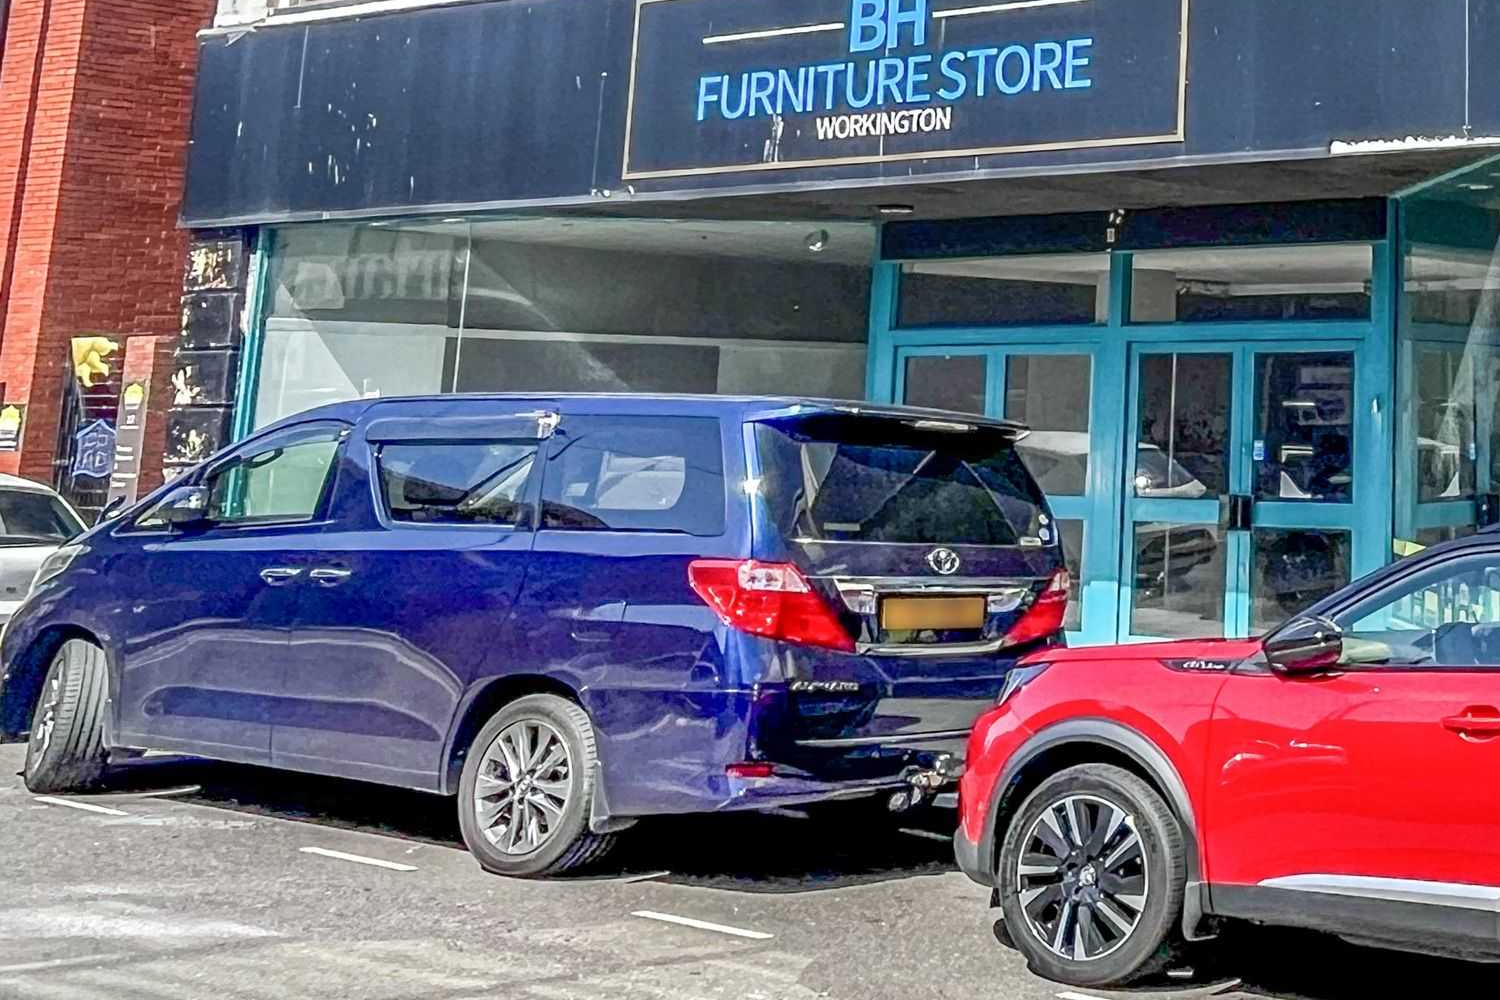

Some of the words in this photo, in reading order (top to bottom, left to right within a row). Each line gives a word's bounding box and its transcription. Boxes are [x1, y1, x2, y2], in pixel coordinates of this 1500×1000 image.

[696, 54, 932, 121] FURNITURE
[935, 38, 1093, 101] STORE
[816, 106, 952, 141] WORKINGTON
